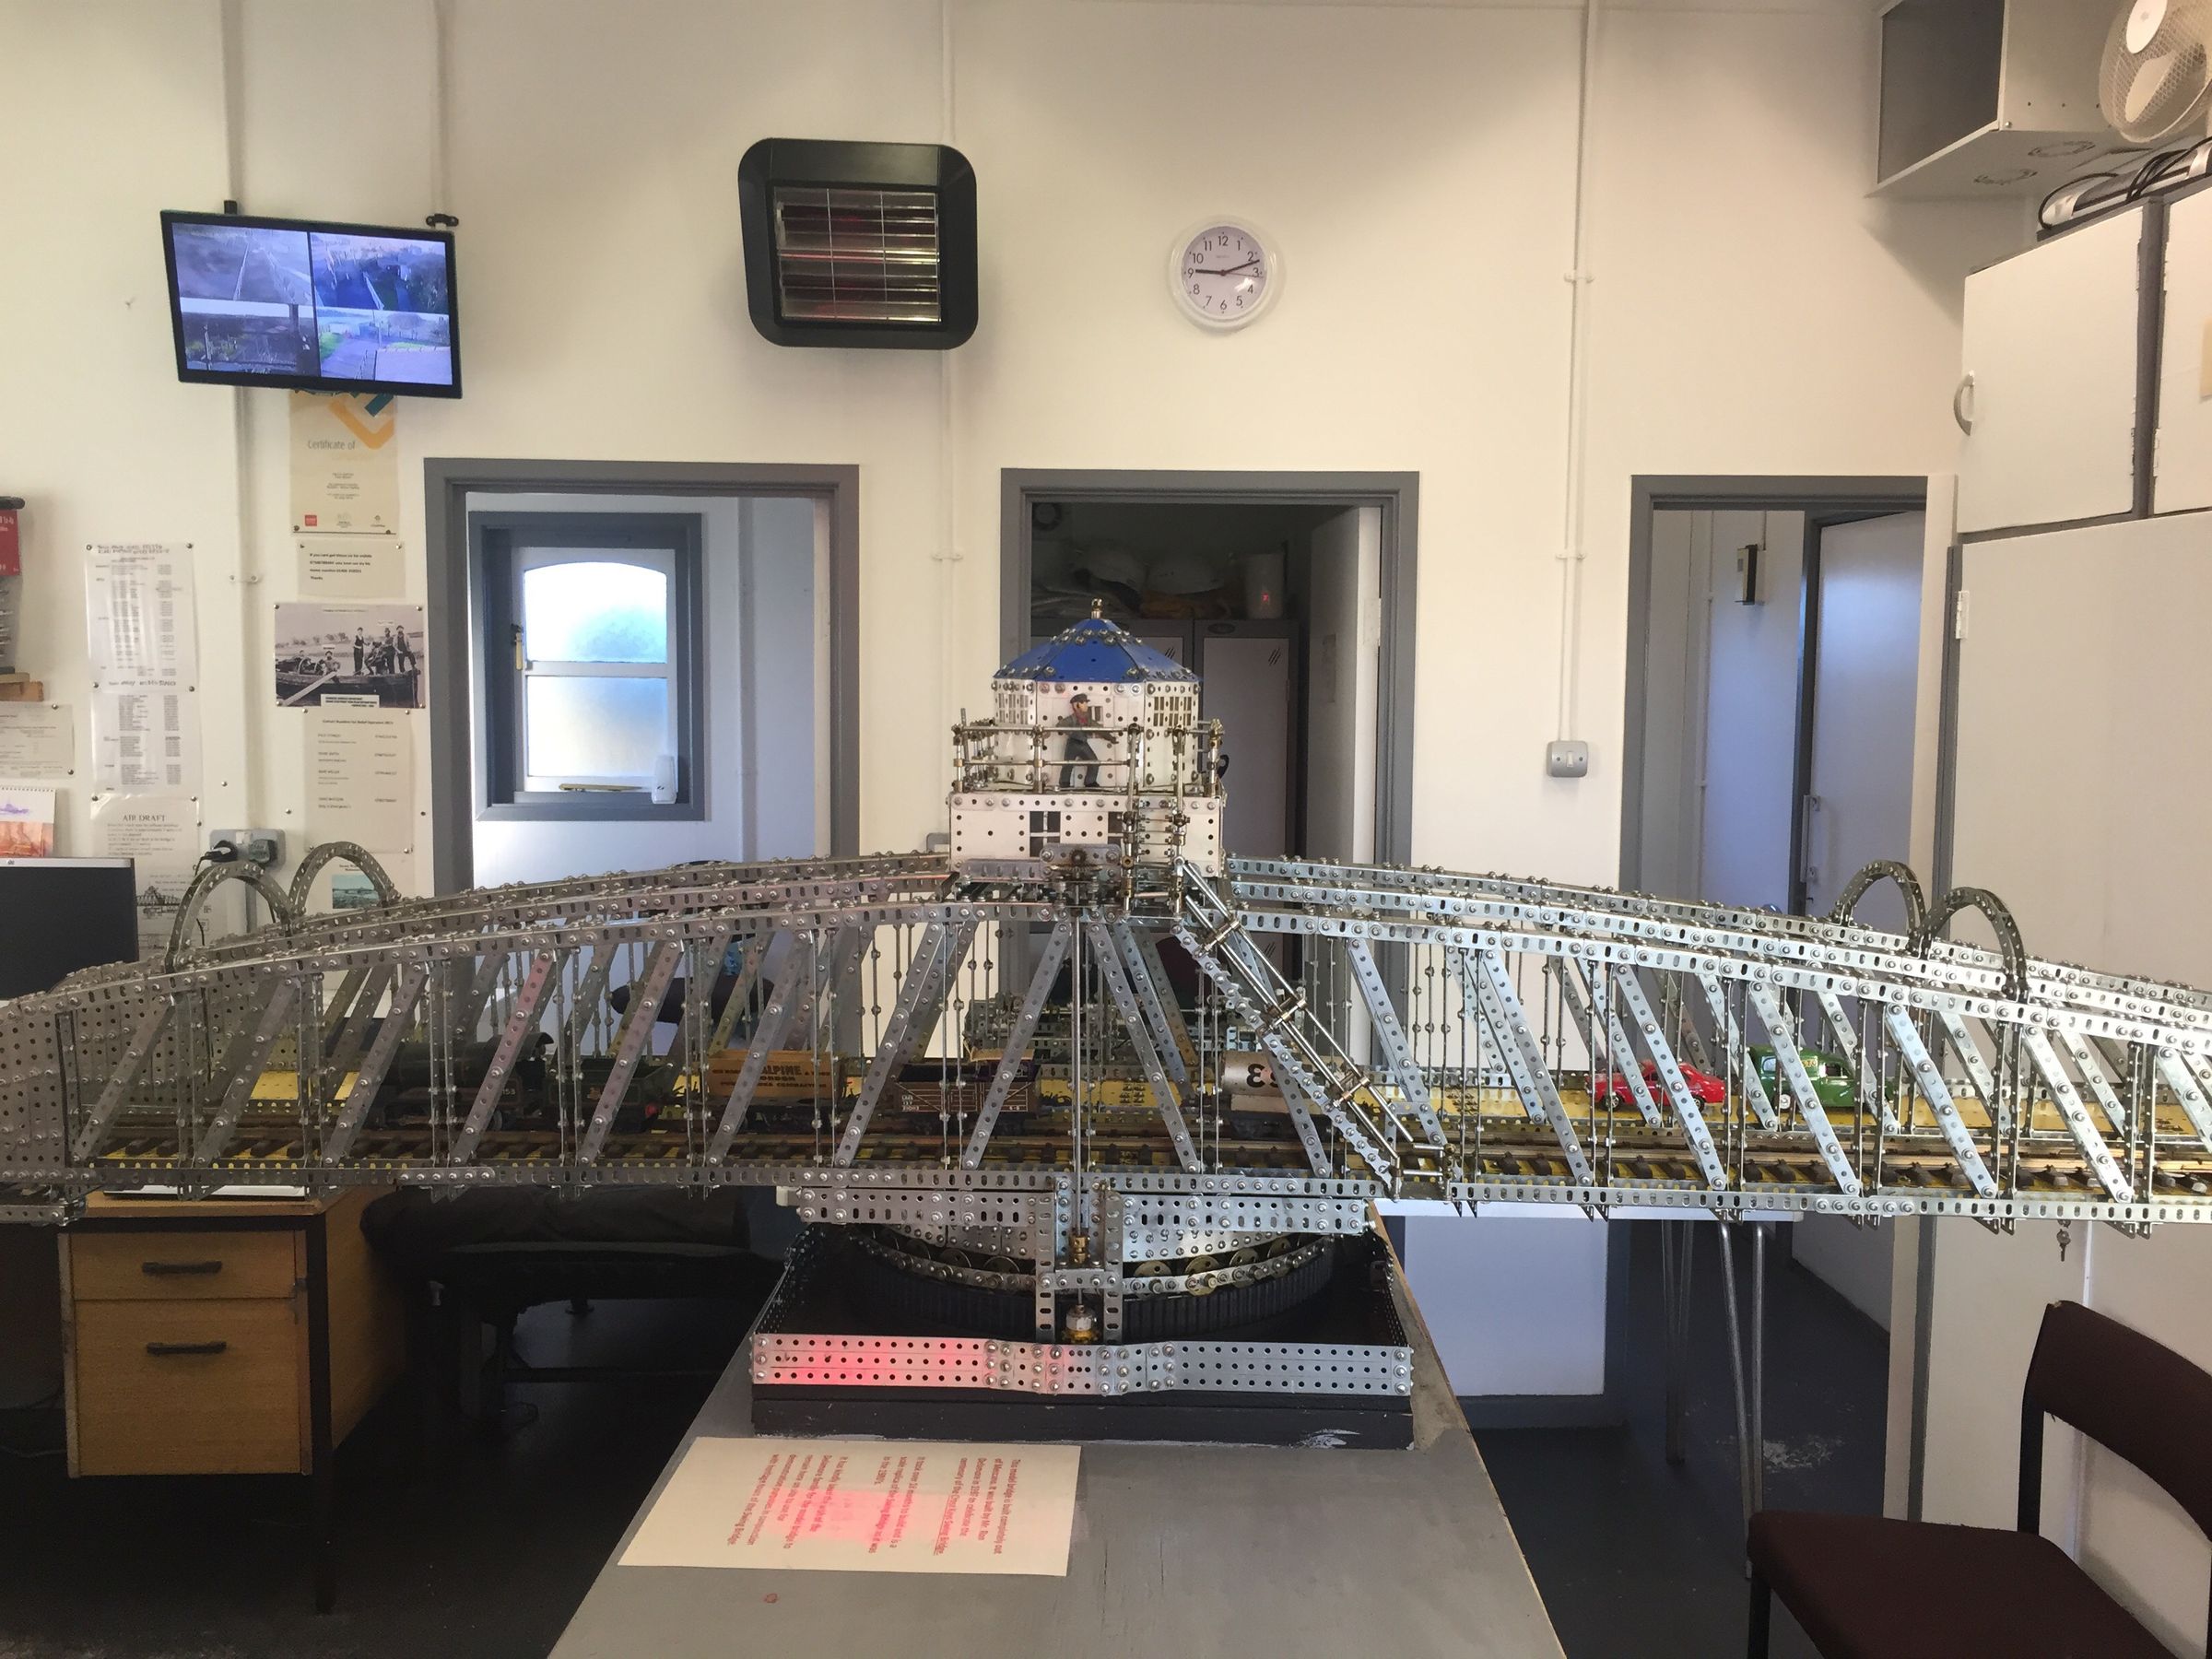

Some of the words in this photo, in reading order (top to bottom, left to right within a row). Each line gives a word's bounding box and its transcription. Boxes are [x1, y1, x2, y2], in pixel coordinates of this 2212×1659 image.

[1205, 241, 1212, 251] 11
[1218, 236, 1228, 246] 12
[1237, 241, 1241, 251] 1
[1193, 253, 1204, 264] 10
[1248, 252, 1254, 262] 2
[1188, 268, 1194, 278] 9
[1253, 267, 1259, 277] 3
[1194, 284, 1200, 295] 8
[1248, 285, 1253, 294] 4
[1206, 296, 1212, 306] 7
[1220, 300, 1227, 310] 6
[1236, 296, 1242, 306] 5
[308, 441, 345, 450] Certificate
[347, 441, 355, 450] of
[761, 1065, 802, 1076] ALPINE
[801, 1454, 813, 1470] remain
[954, 1457, 968, 1480] centenary
[758, 1465, 776, 1484] heritage
[774, 1454, 797, 1488] demonstration
[829, 1469, 843, 1482] kindly
[892, 1468, 903, 1484] replica
[1007, 1468, 1018, 1483] model
[807, 1477, 824, 1491] family
[1003, 1483, 1017, 1498] bridge
[902, 1489, 914, 1508] months
[880, 1499, 896, 1513] Swing
[735, 1512, 752, 1527] Swing
[794, 1509, 806, 1524] model
[875, 1513, 890, 1530] Bridge
[961, 1504, 975, 1526] celebrate
[747, 1515, 767, 1546] conjunction
[784, 1525, 802, 1542] bridge
[938, 1520, 954, 1535] Swing
[994, 1516, 1008, 1544] completely
